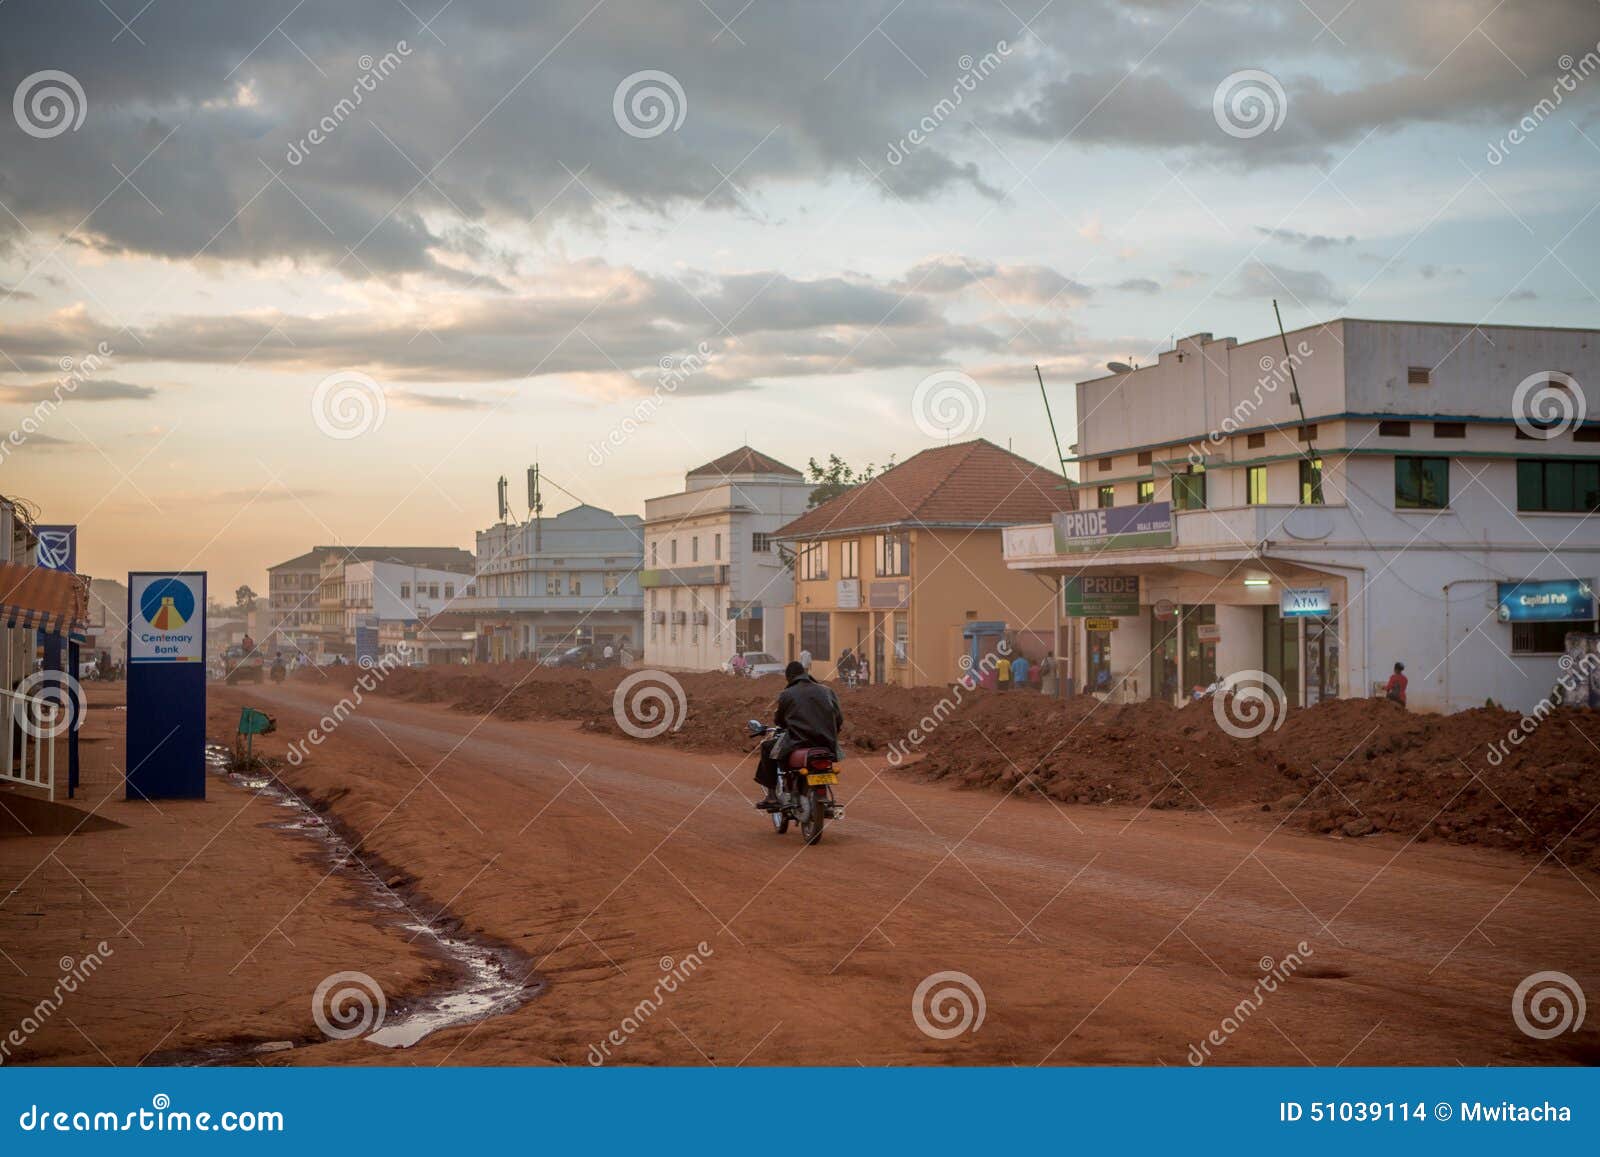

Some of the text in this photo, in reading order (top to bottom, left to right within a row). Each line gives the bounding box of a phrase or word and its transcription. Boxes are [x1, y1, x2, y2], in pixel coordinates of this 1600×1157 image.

[1067, 511, 1107, 537] PRIDE
[1084, 577, 1137, 593] PRIDE
[1293, 597, 1318, 608] ATM
[1520, 593, 1568, 607] Capital Pub
[141, 633, 193, 644] Centenary
[155, 645, 179, 654] Bank
